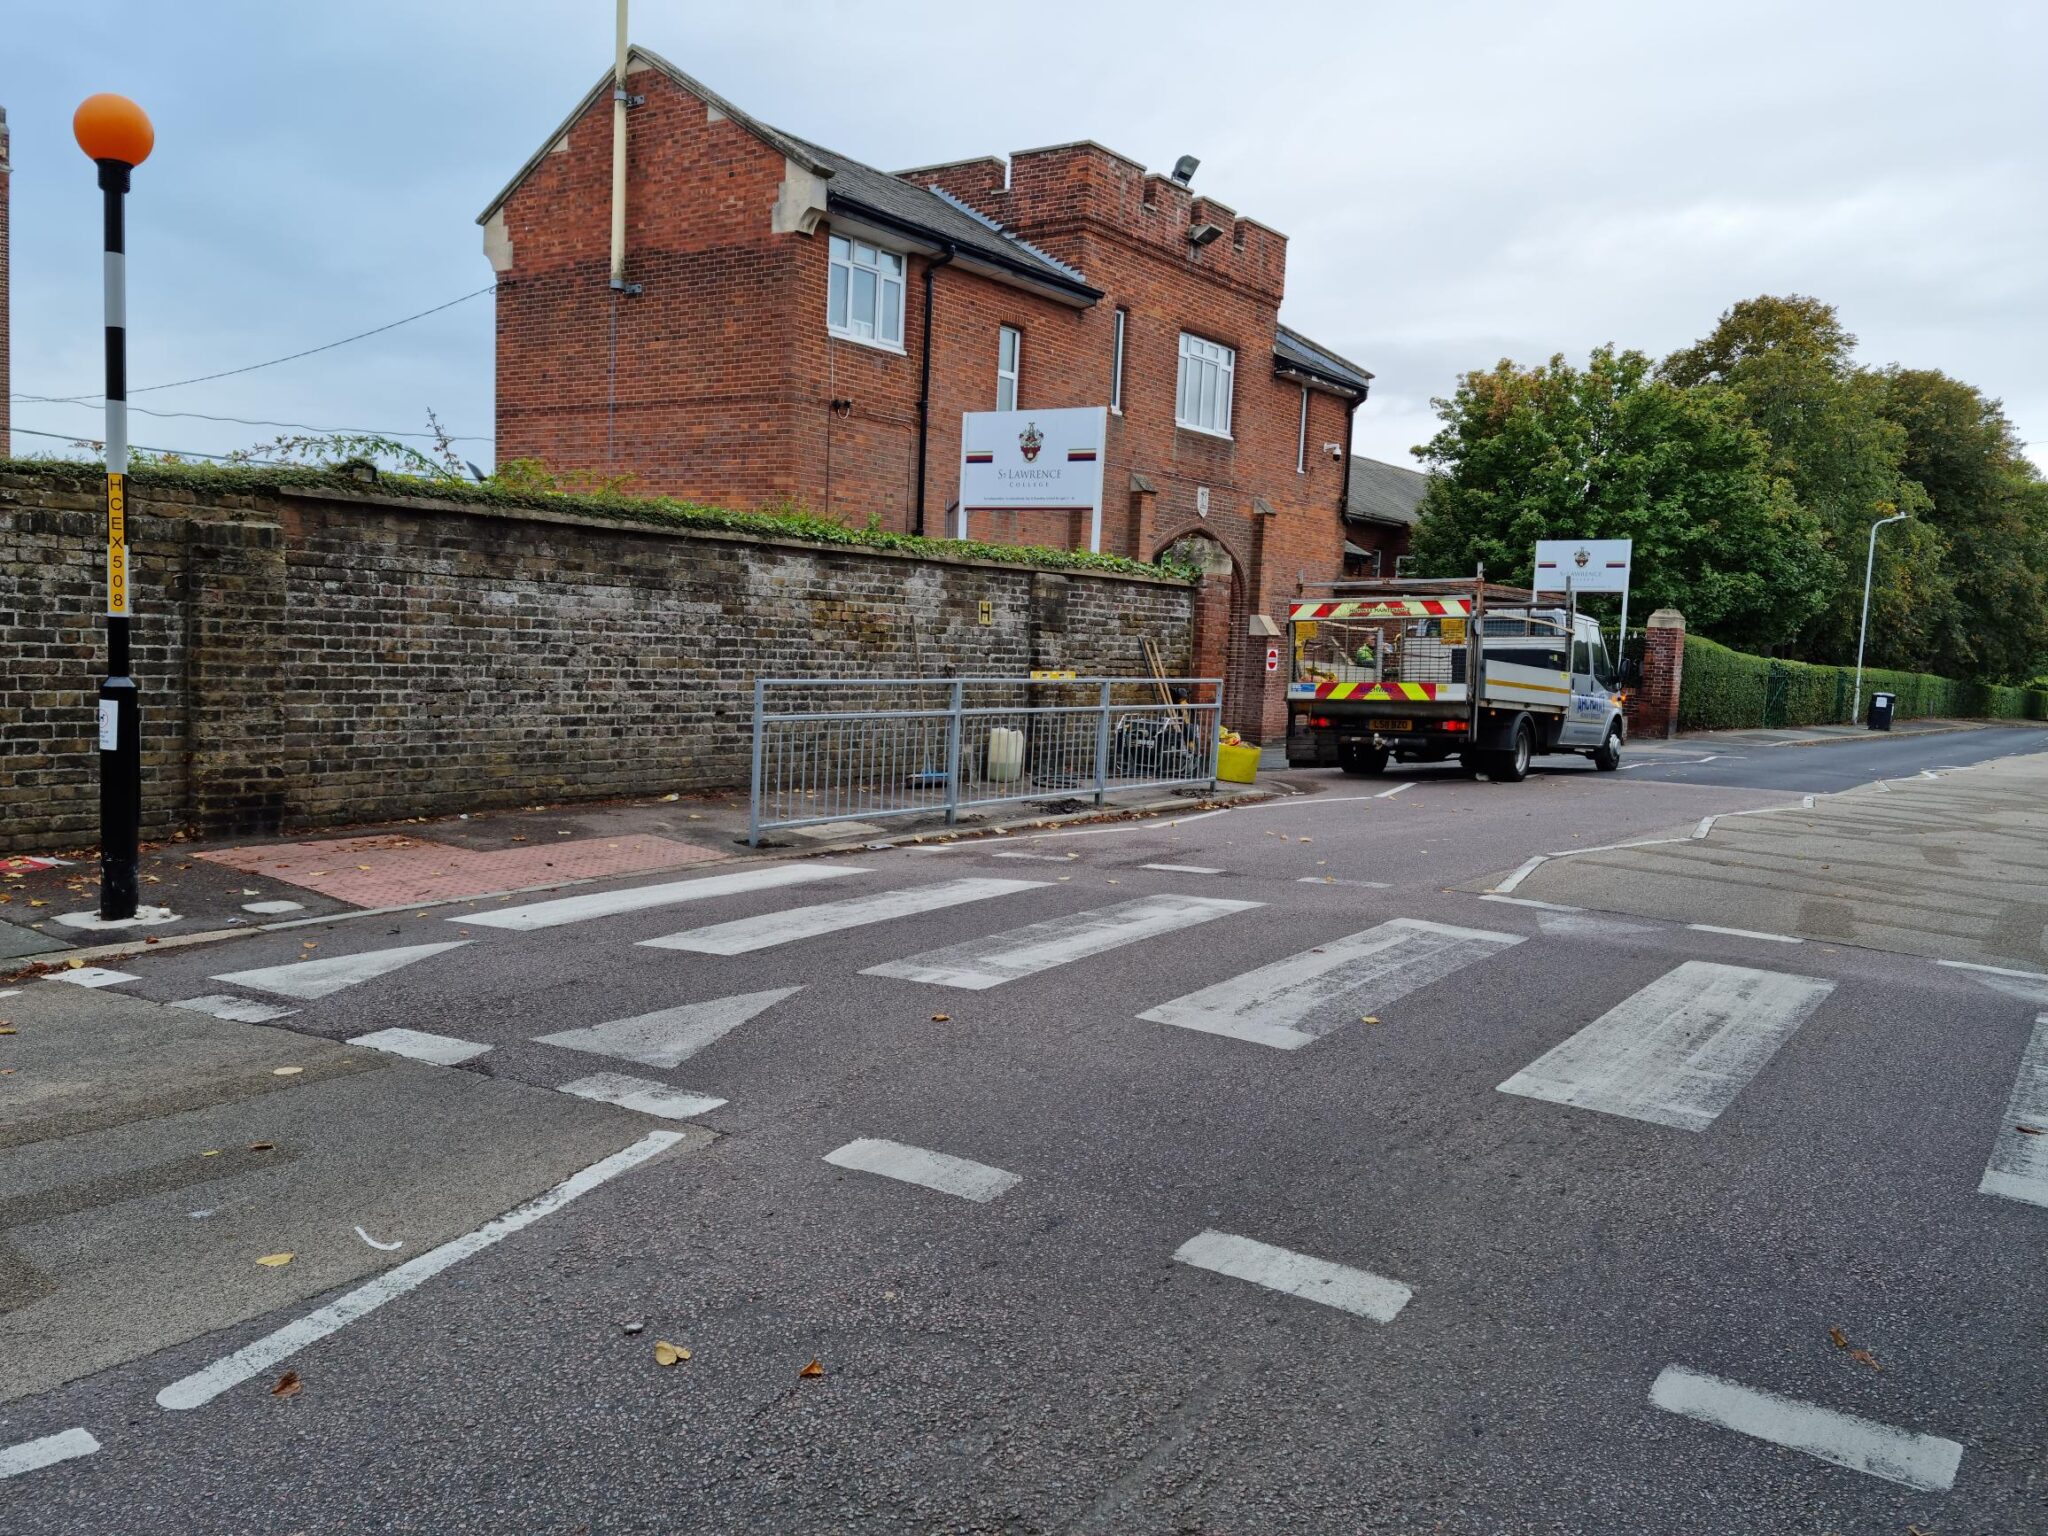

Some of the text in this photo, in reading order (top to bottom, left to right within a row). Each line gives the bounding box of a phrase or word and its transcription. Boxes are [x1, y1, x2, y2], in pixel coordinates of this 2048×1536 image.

[1008, 468, 1062, 480] LAWRENCE
[109, 478, 124, 607] HCEX508
[980, 602, 990, 622] H
